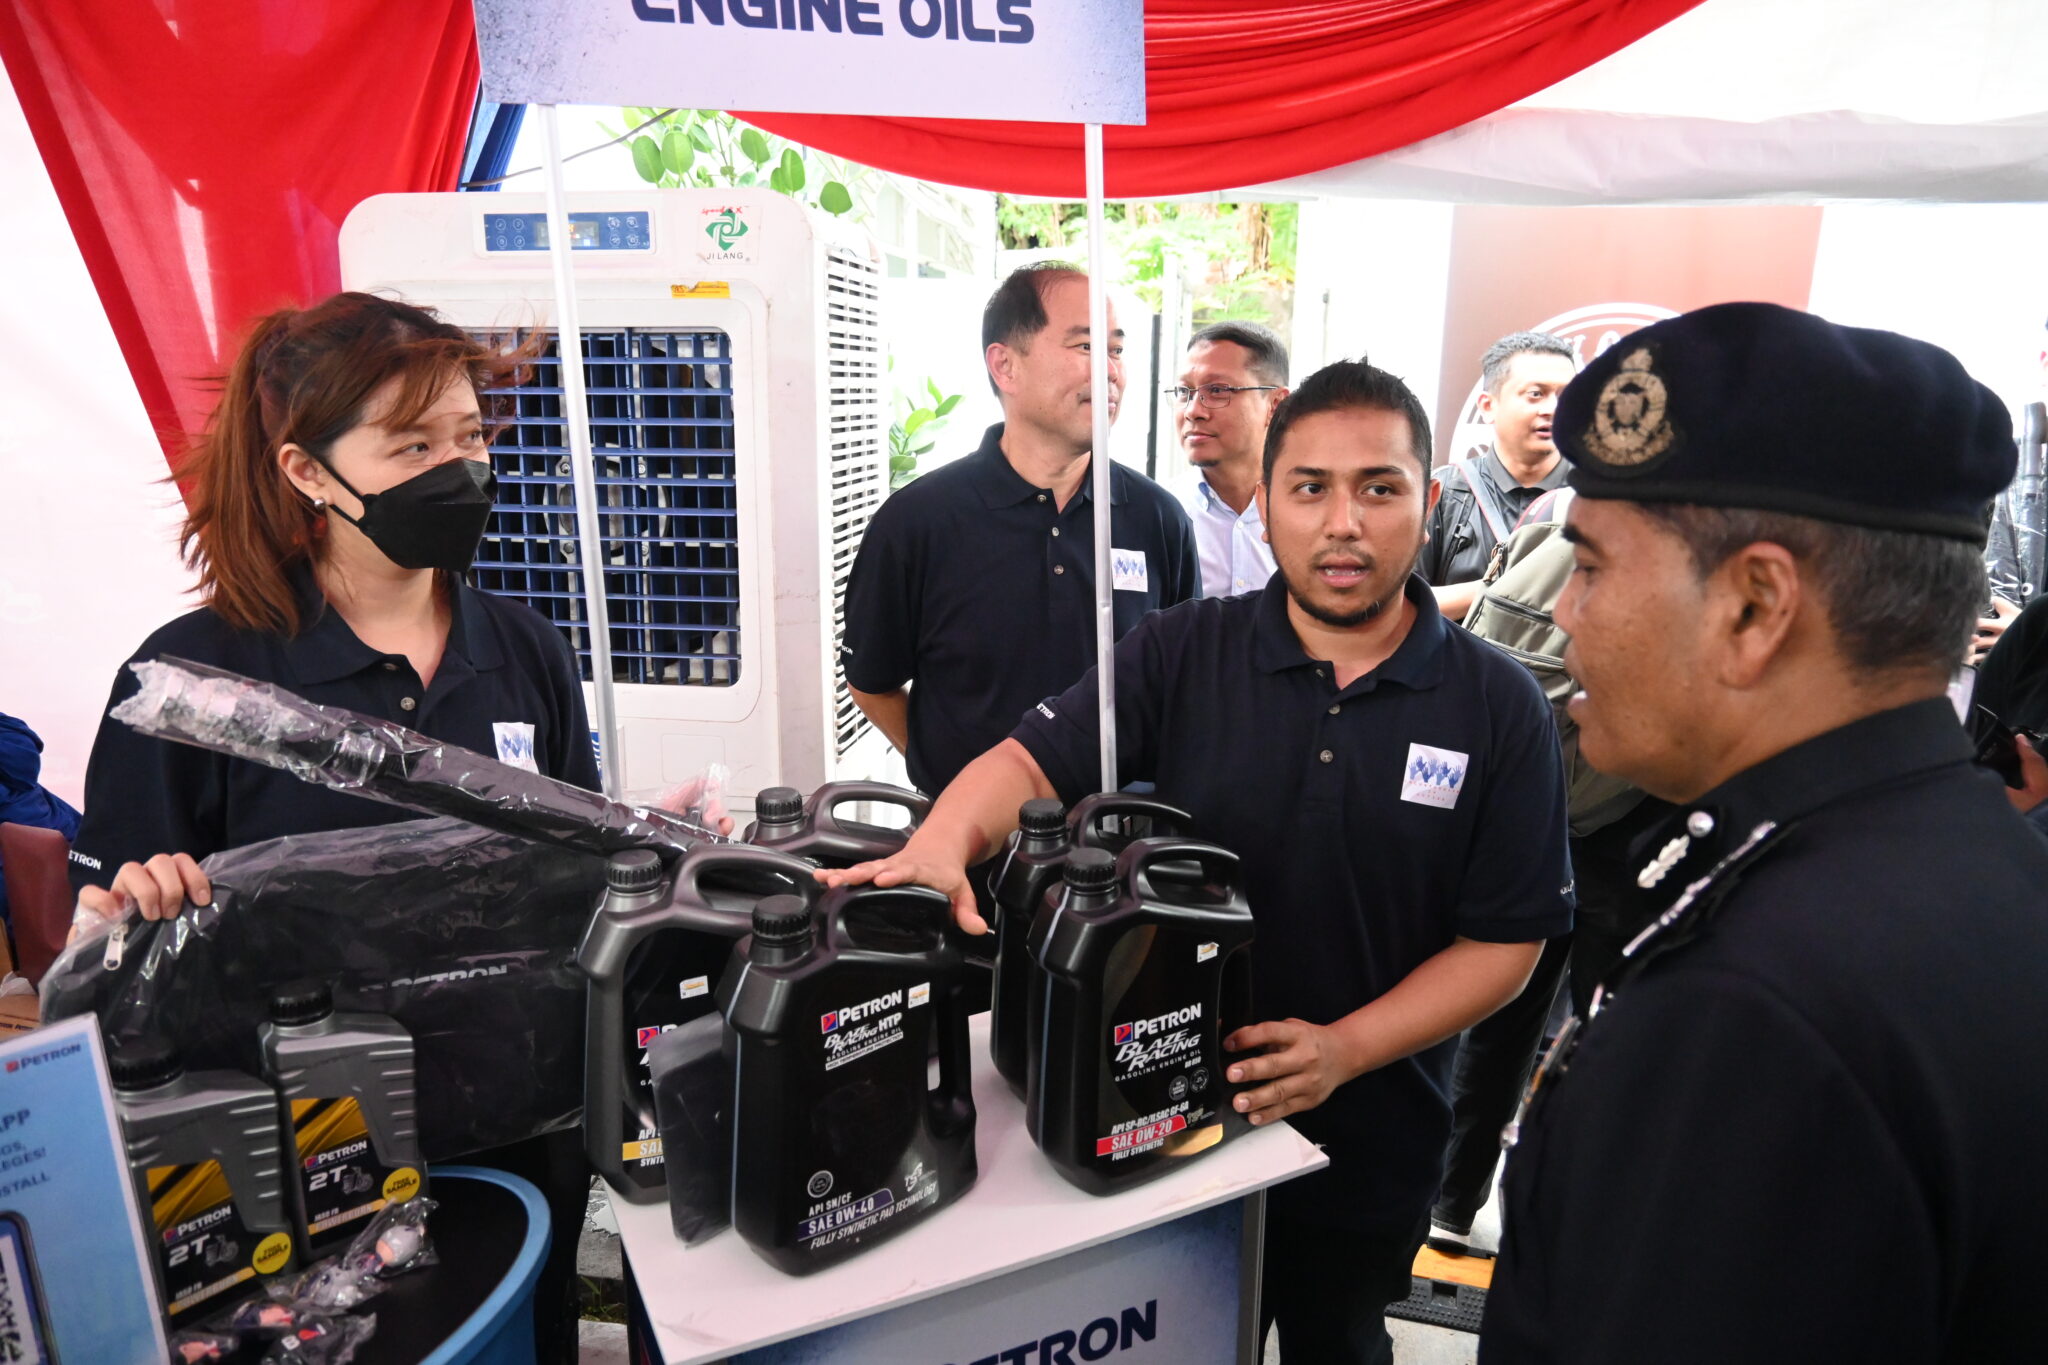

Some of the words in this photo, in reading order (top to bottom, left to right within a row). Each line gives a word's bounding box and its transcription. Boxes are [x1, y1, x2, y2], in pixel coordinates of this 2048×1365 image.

[899, 0, 1035, 44] OILS
[1036, 702, 1056, 720] ETRON
[68, 850, 102, 870] ETRON
[839, 989, 903, 1027] PETRON
[1134, 1002, 1202, 1040] PETRON
[824, 1023, 871, 1049] BLAZE
[832, 1026, 879, 1054] RACING
[878, 1012, 903, 1032] HTP
[1115, 1028, 1190, 1063] BLAZE
[20, 1044, 82, 1069] PETRON
[1114, 1065, 1157, 1082] GASOLINE
[1159, 1055, 1187, 1069] ENGINE
[1190, 1049, 1201, 1057] OIL
[1128, 1033, 1202, 1072] RACING
[0, 1108, 31, 1133] PP
[638, 1128, 656, 1141] API
[1111, 1122, 1125, 1135] API
[1111, 1134, 1134, 1151] SAE
[1136, 1119, 1173, 1144] 0W-20
[0, 1147, 46, 1173] EGES!
[318, 1140, 368, 1164] PETRON
[1112, 1150, 1130, 1161] FULLY
[1130, 1138, 1165, 1157] SYNTHETIC
[0, 1170, 51, 1198] STALL
[309, 1164, 348, 1192] 2T
[178, 1205, 232, 1236] PETRON
[808, 1203, 824, 1217] API
[808, 1212, 834, 1235] SAE
[836, 1197, 875, 1225] 0W-40
[810, 1231, 836, 1250] FULLY
[837, 1213, 880, 1240] SYNTHETIC
[895, 1181, 938, 1213] TECHNOLOGY
[168, 1233, 210, 1267] 2T
[944, 1299, 1157, 1365] TRON
